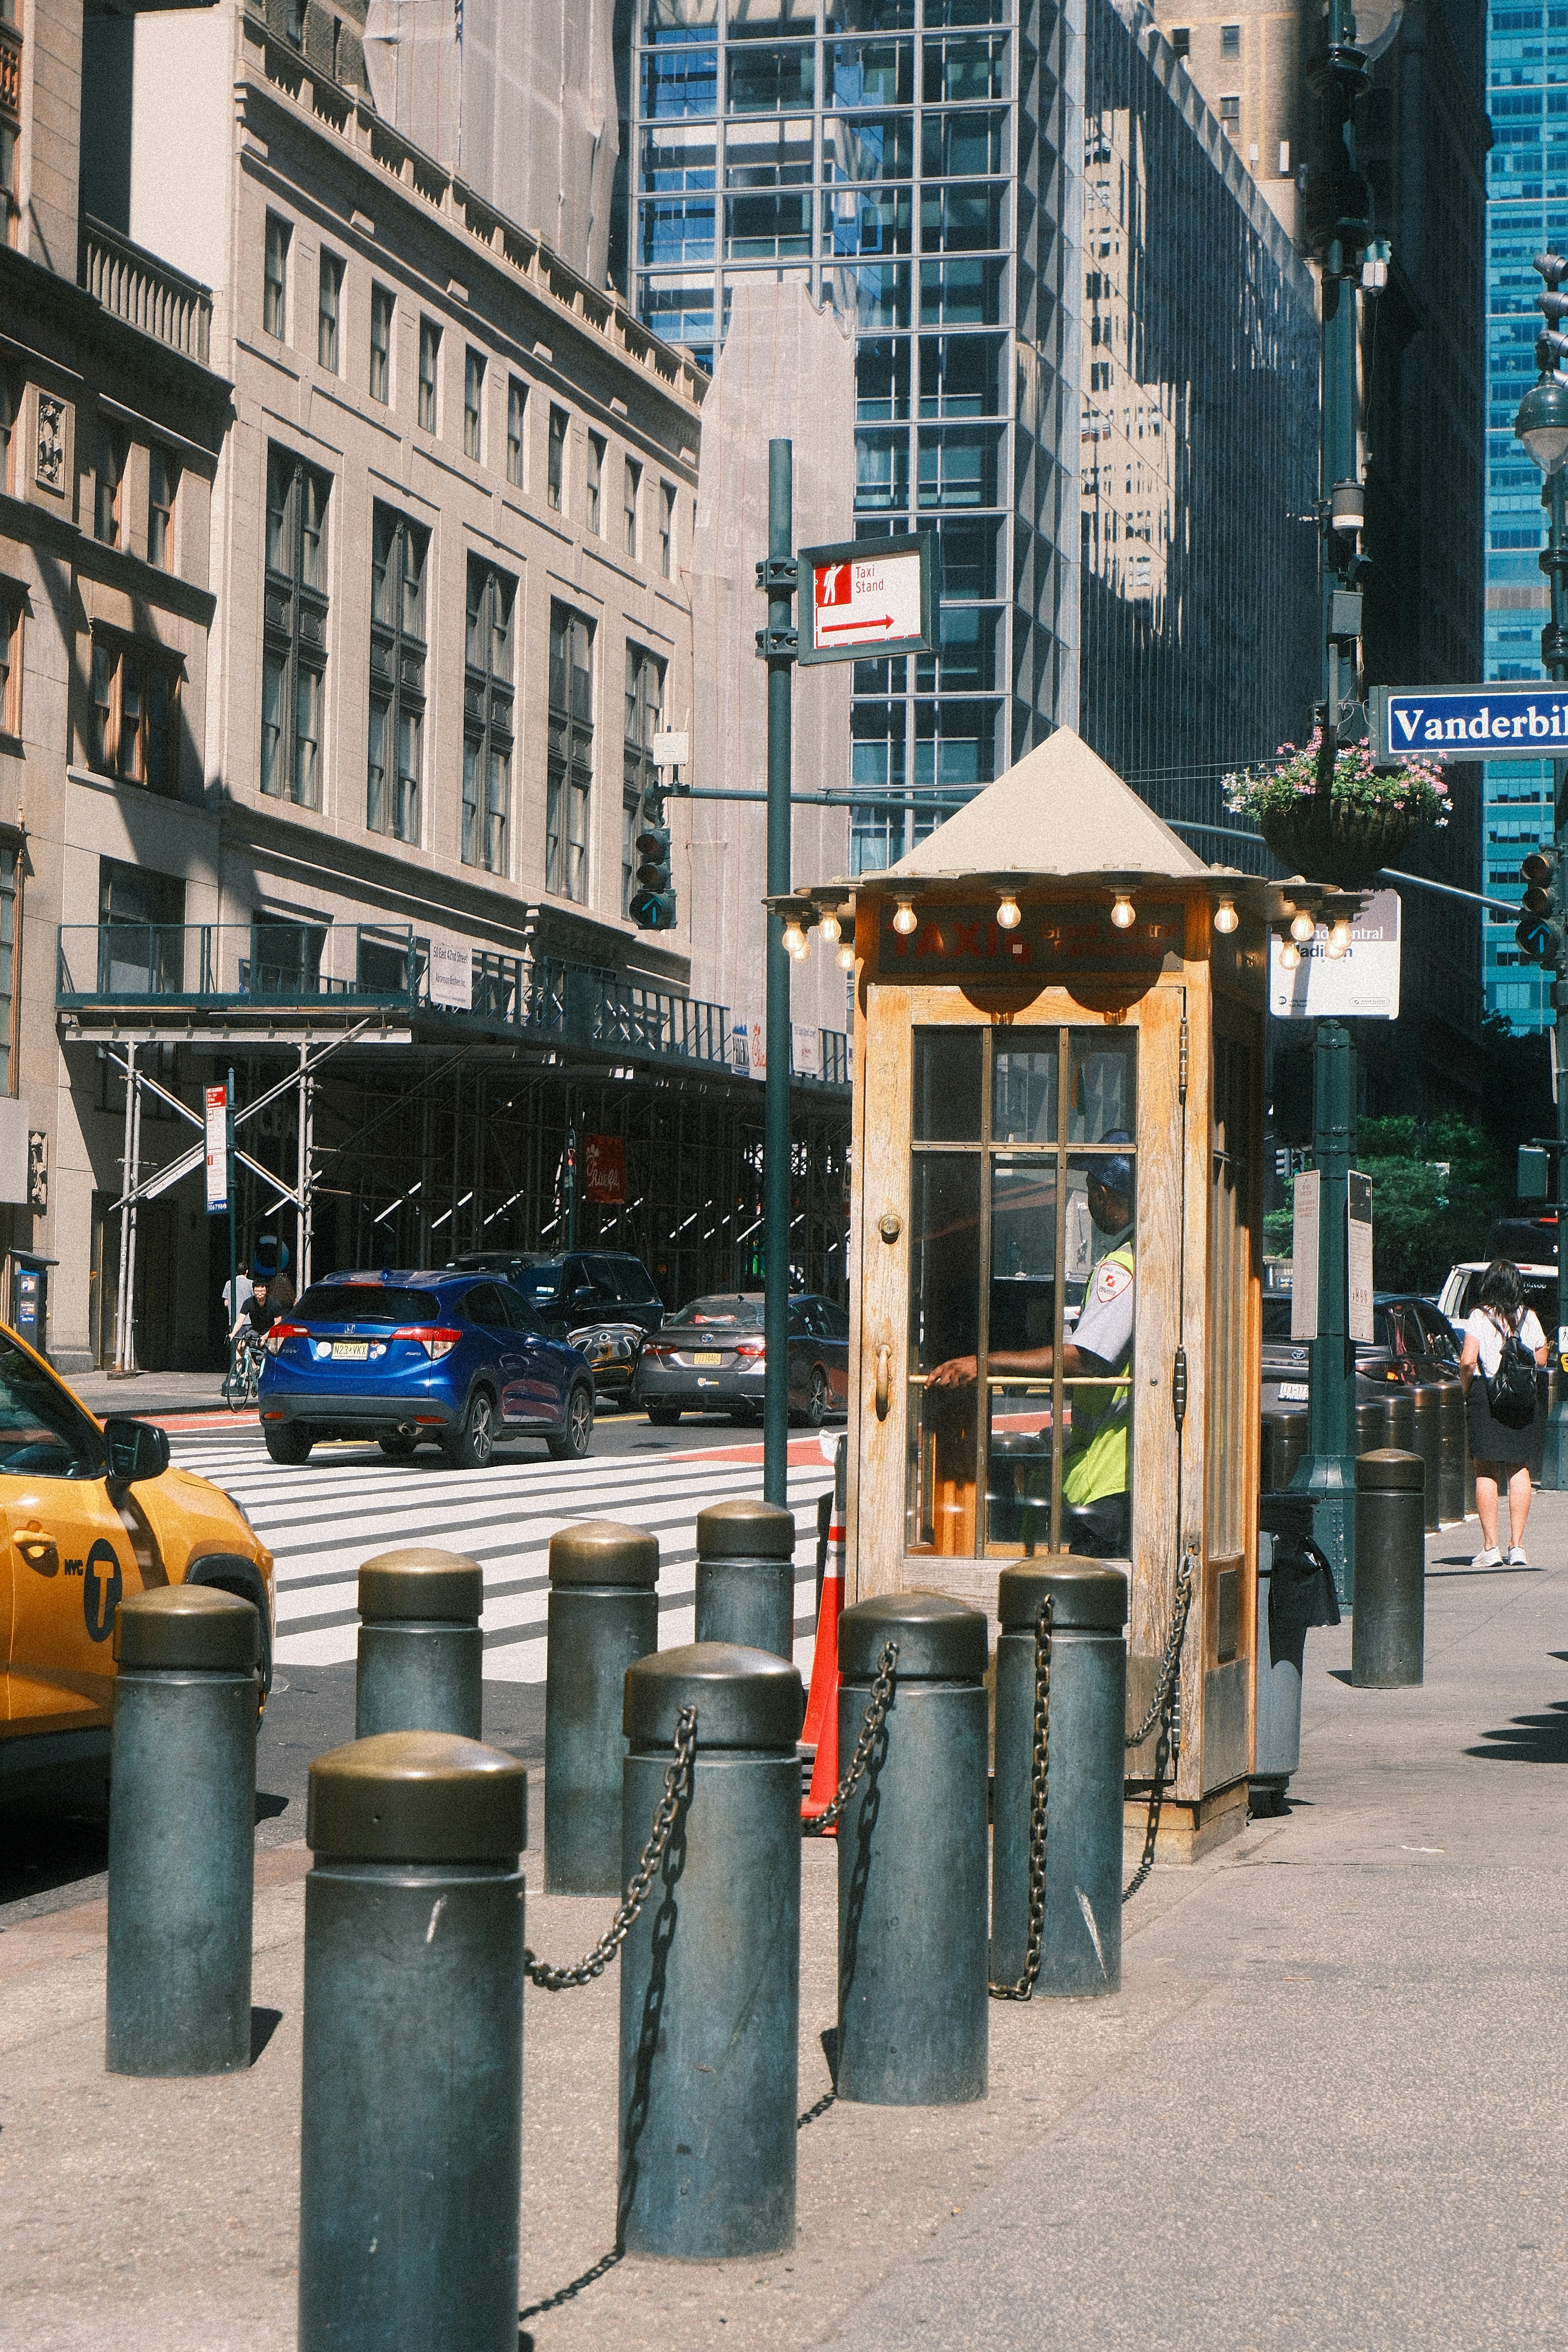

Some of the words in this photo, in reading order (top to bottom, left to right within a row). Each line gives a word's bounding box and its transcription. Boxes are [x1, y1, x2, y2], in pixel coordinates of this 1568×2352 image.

[855, 564, 875, 579] Taxi
[855, 578, 884, 594] Stand
[886, 920, 998, 958] TAXI
[433, 946, 439, 957] 50
[447, 949, 456, 962] 42nd
[457, 951, 468, 964] Street
[450, 975, 461, 987] Brothers
[64, 1559, 84, 1576] NYC
